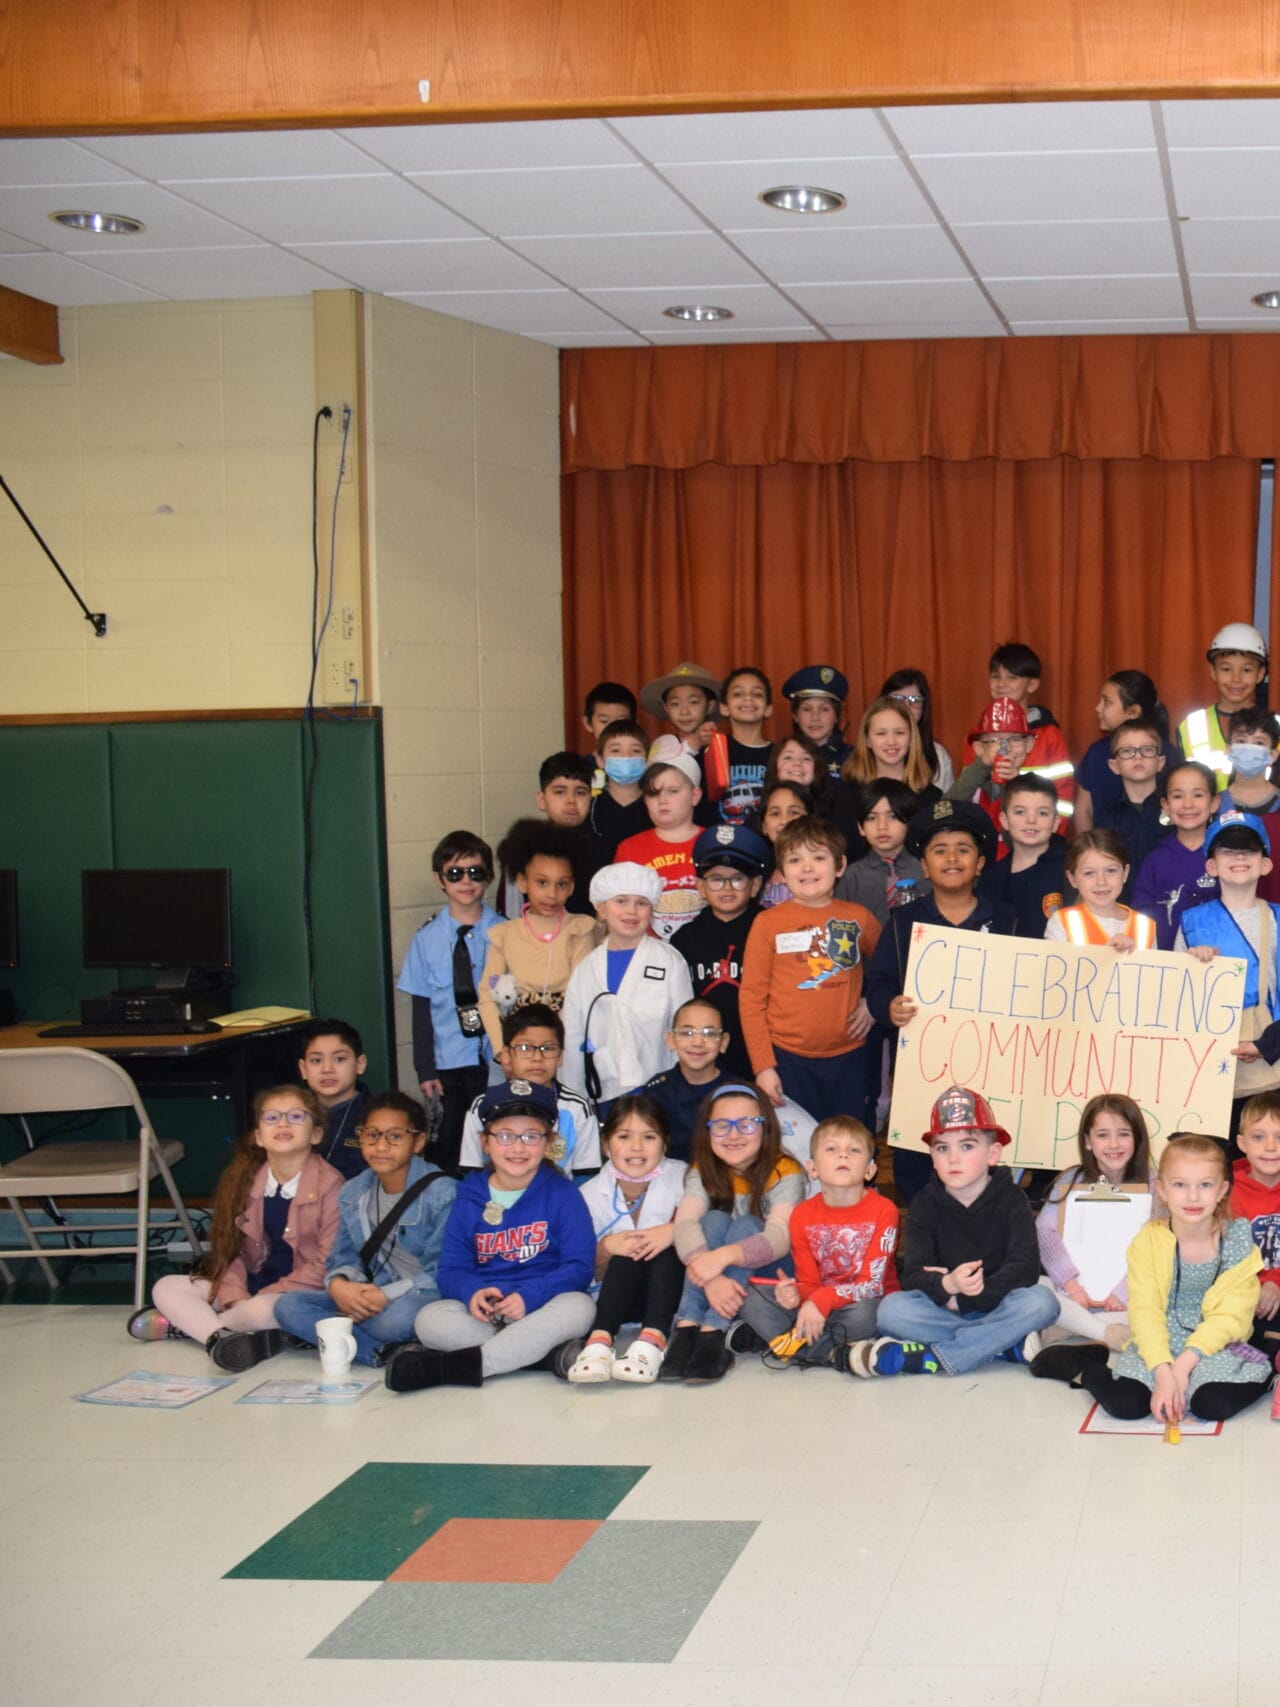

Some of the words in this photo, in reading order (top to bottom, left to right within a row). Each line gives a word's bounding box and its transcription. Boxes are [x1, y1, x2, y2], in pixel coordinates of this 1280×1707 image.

[731, 765, 766, 782] UTUR
[645, 853, 686, 871] AMEN
[915, 939, 1240, 1035] CELEBRATING
[918, 1014, 1217, 1107] COMMUNITY
[942, 1097, 971, 1107] FIRE
